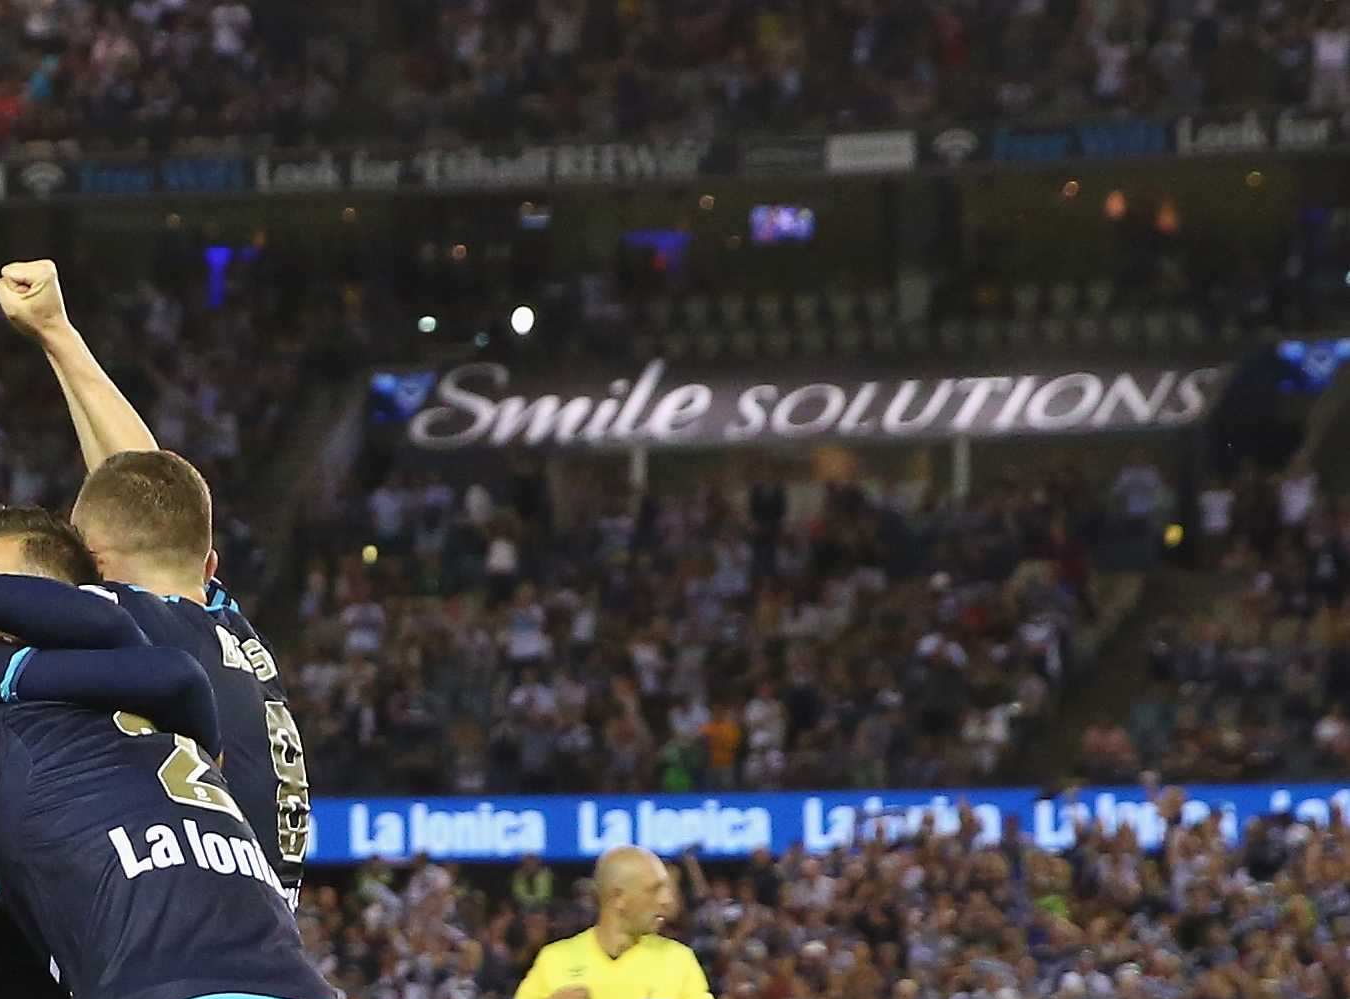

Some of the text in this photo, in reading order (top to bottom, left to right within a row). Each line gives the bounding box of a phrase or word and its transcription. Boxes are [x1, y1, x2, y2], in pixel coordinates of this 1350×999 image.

[408, 356, 1222, 449] Smile SOLUTIONS
[108, 823, 185, 879] La
[351, 803, 405, 858] La
[409, 803, 547, 857] Ionica
[578, 798, 772, 855] La Ionica
[803, 797, 856, 855] La
